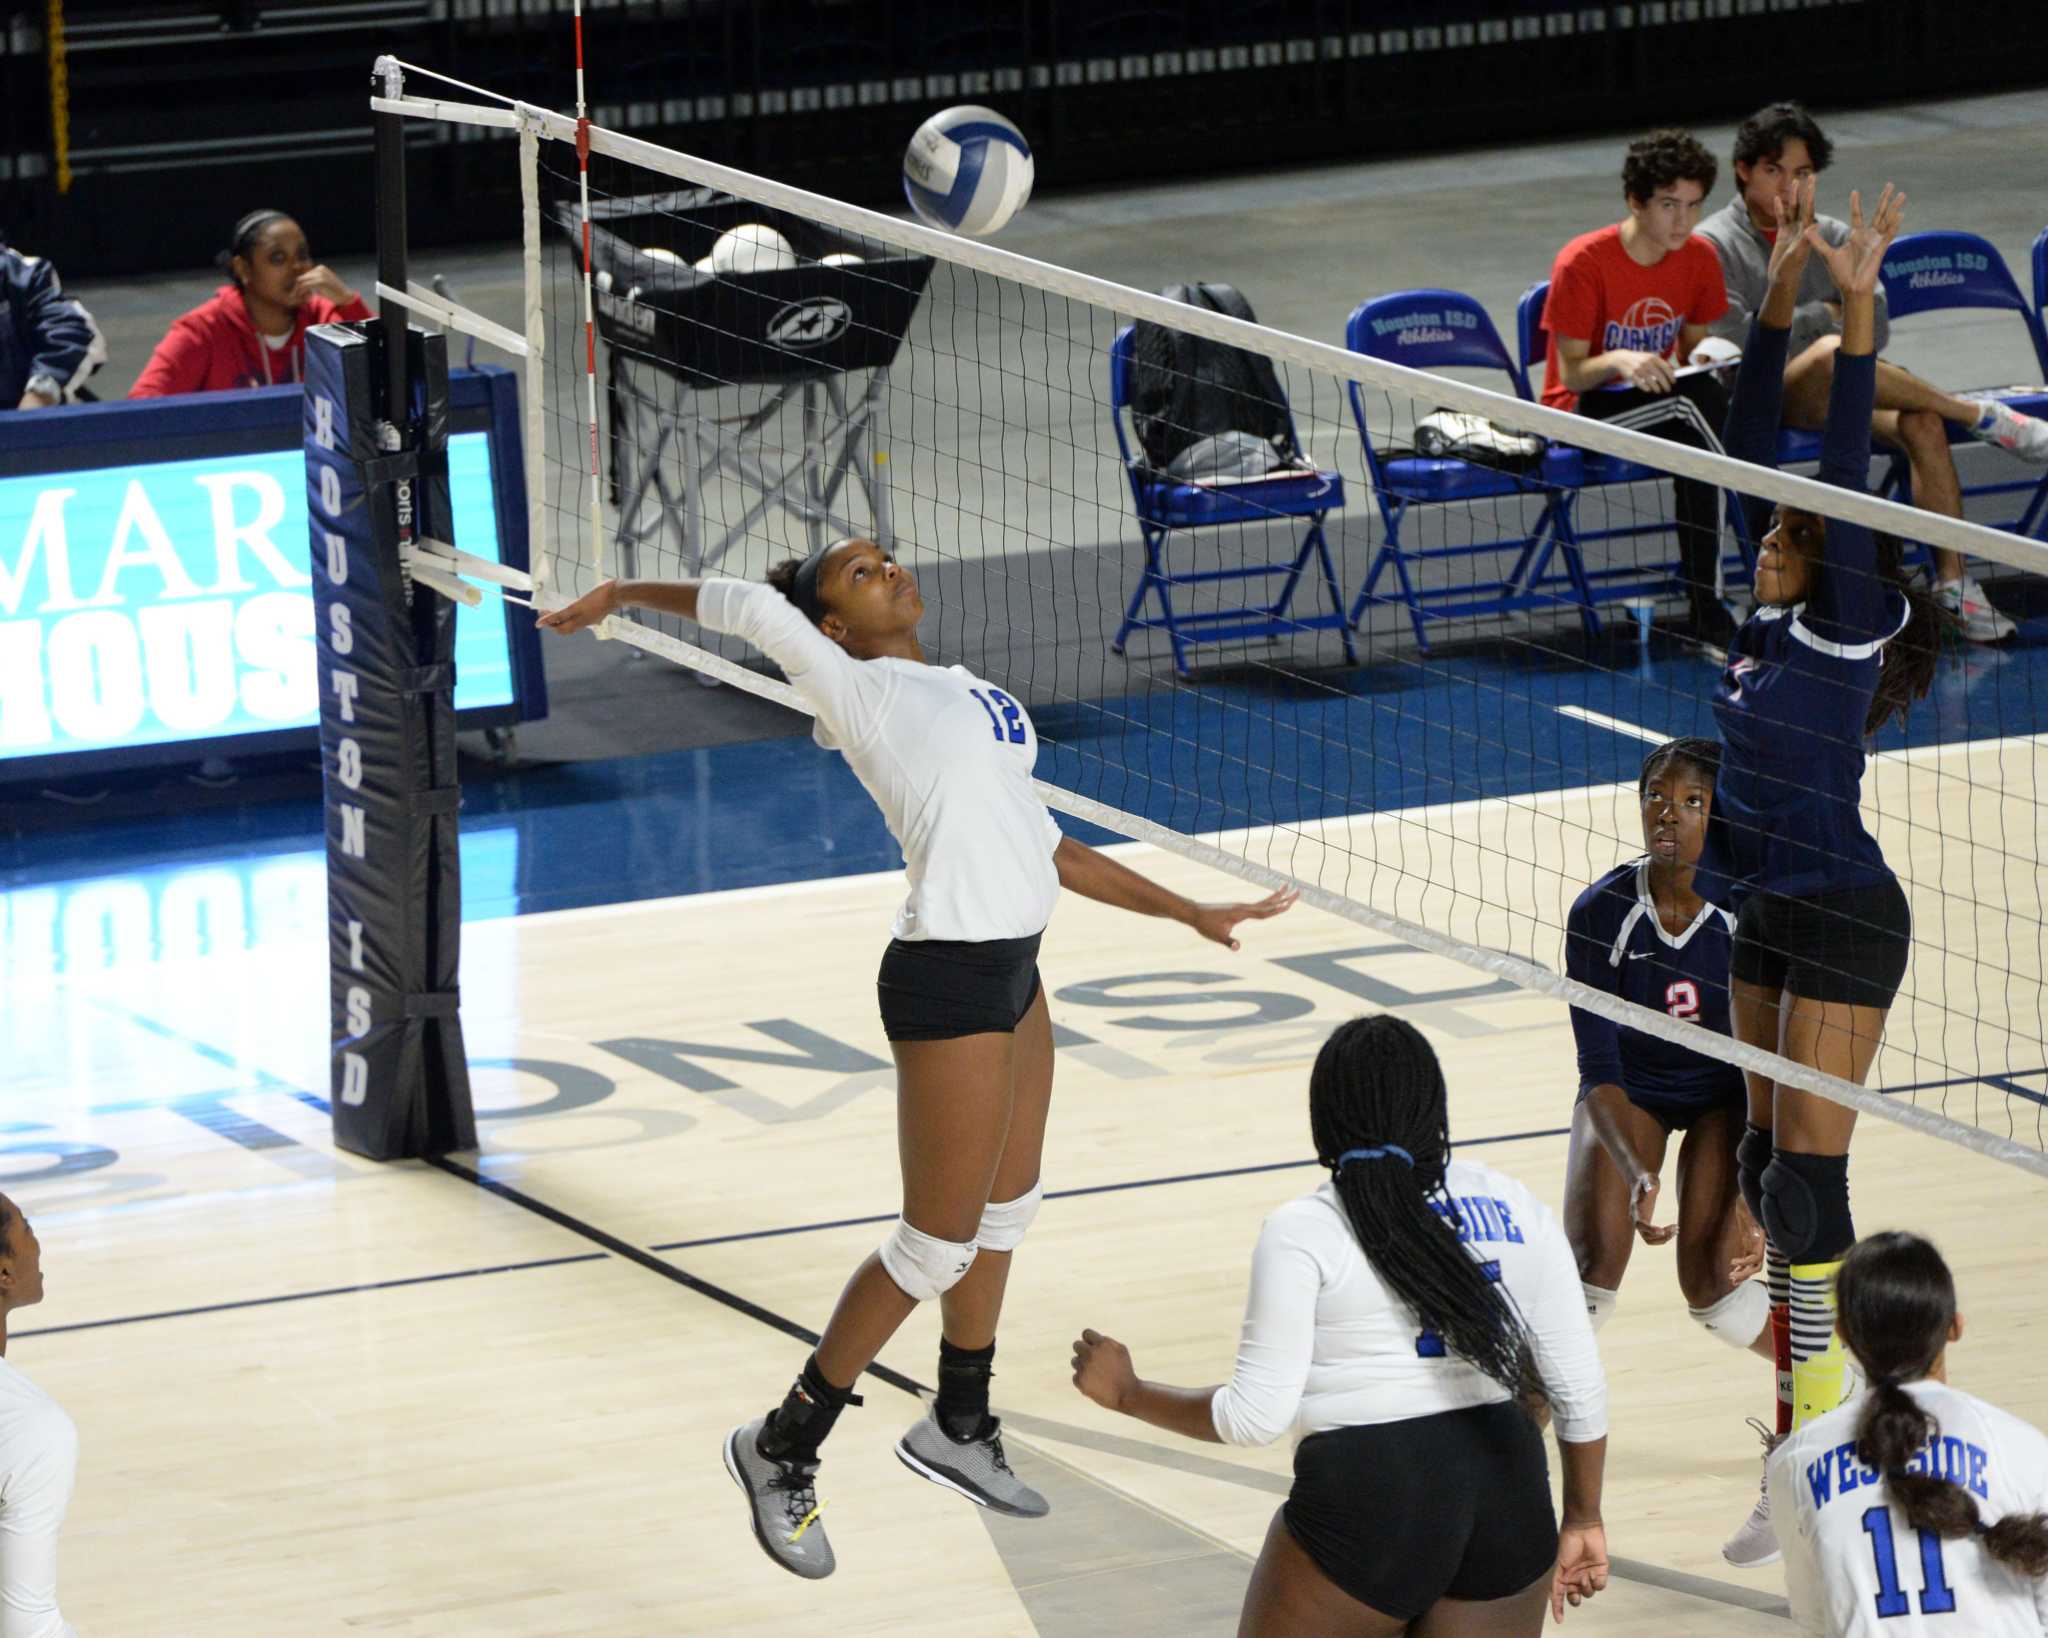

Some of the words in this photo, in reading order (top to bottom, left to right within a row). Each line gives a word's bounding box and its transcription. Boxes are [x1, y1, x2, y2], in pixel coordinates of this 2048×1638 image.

[1883, 256, 1952, 278] Houston
[1956, 252, 1989, 271] ISD
[1909, 270, 1965, 288] Athletics
[1371, 312, 1441, 335] Houston
[1445, 309, 1478, 329] ISD
[1397, 327, 1454, 345] Athletics
[969, 689, 1026, 744] 12
[341, 921, 371, 1106] ISD
[1665, 979, 1701, 1022] 2
[1861, 1504, 1956, 1619] 11
